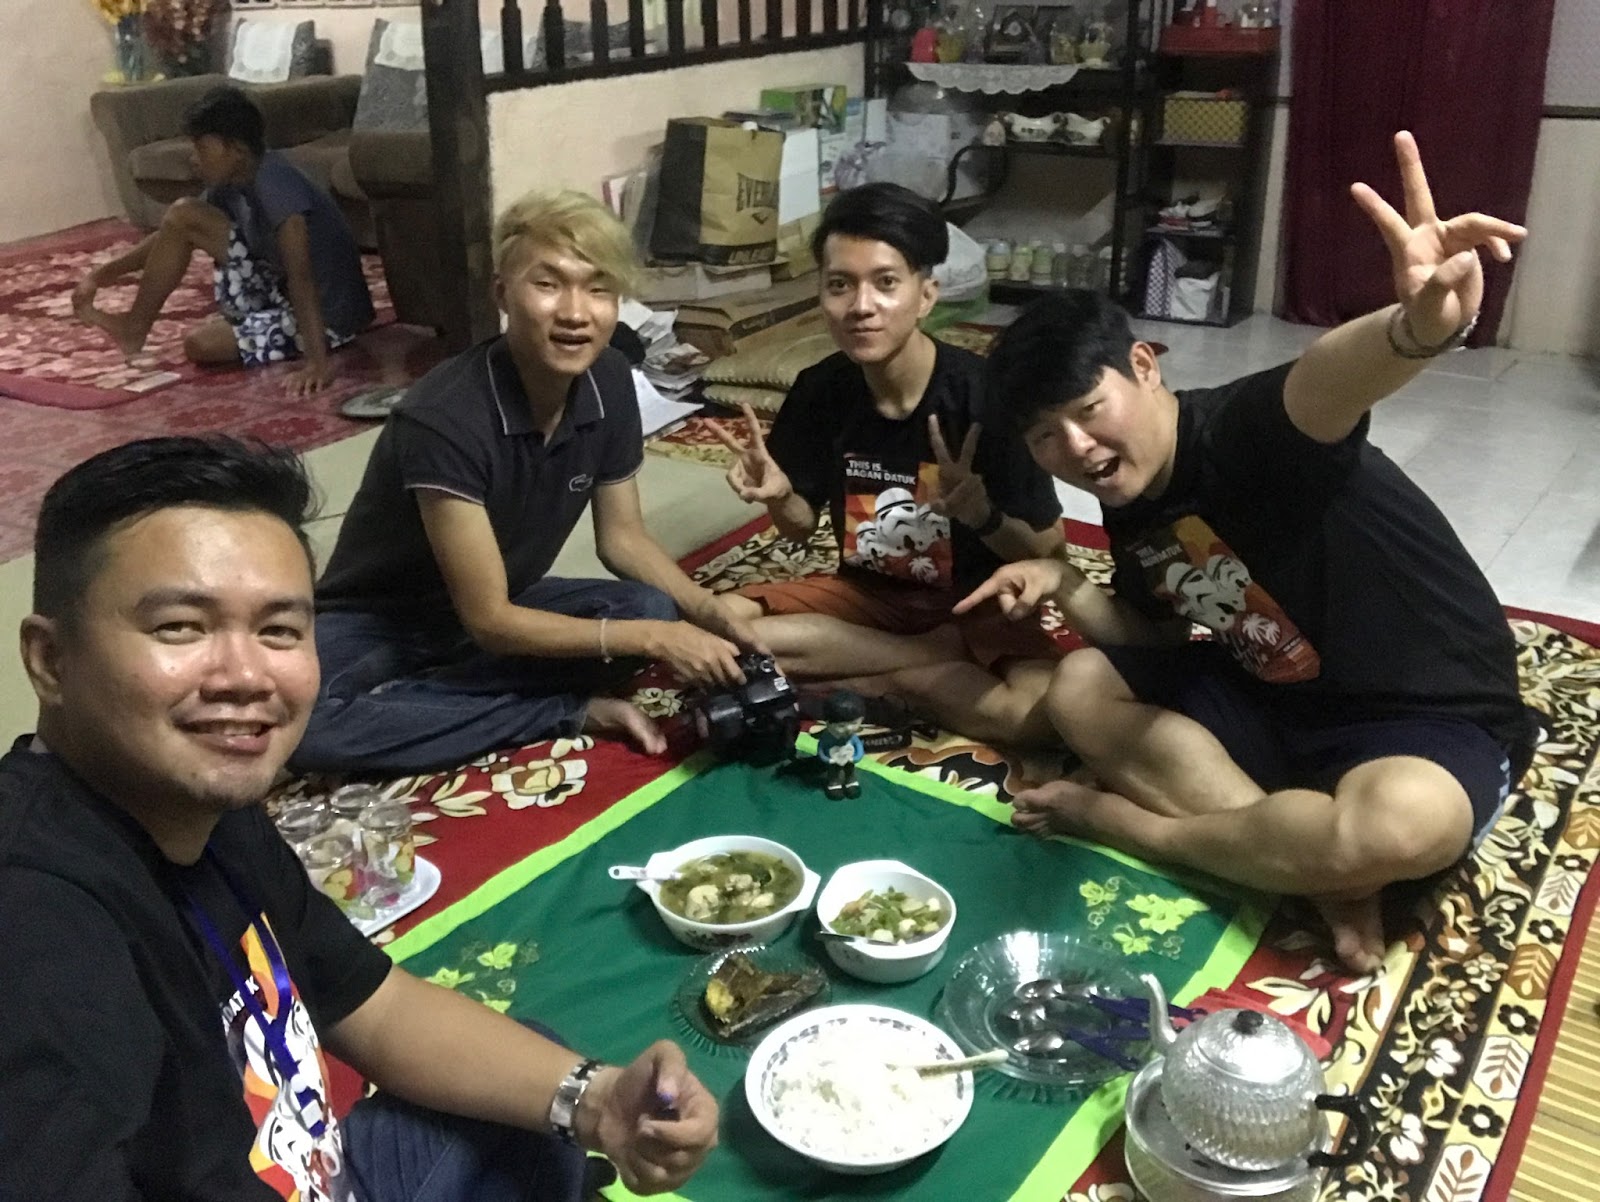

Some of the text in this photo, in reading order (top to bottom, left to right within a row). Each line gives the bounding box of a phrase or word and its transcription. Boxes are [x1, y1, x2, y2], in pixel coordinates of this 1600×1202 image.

[848, 460, 870, 470] THIS
[846, 469, 916, 485] BAGAN DATUK
[222, 974, 260, 1024] DATK
